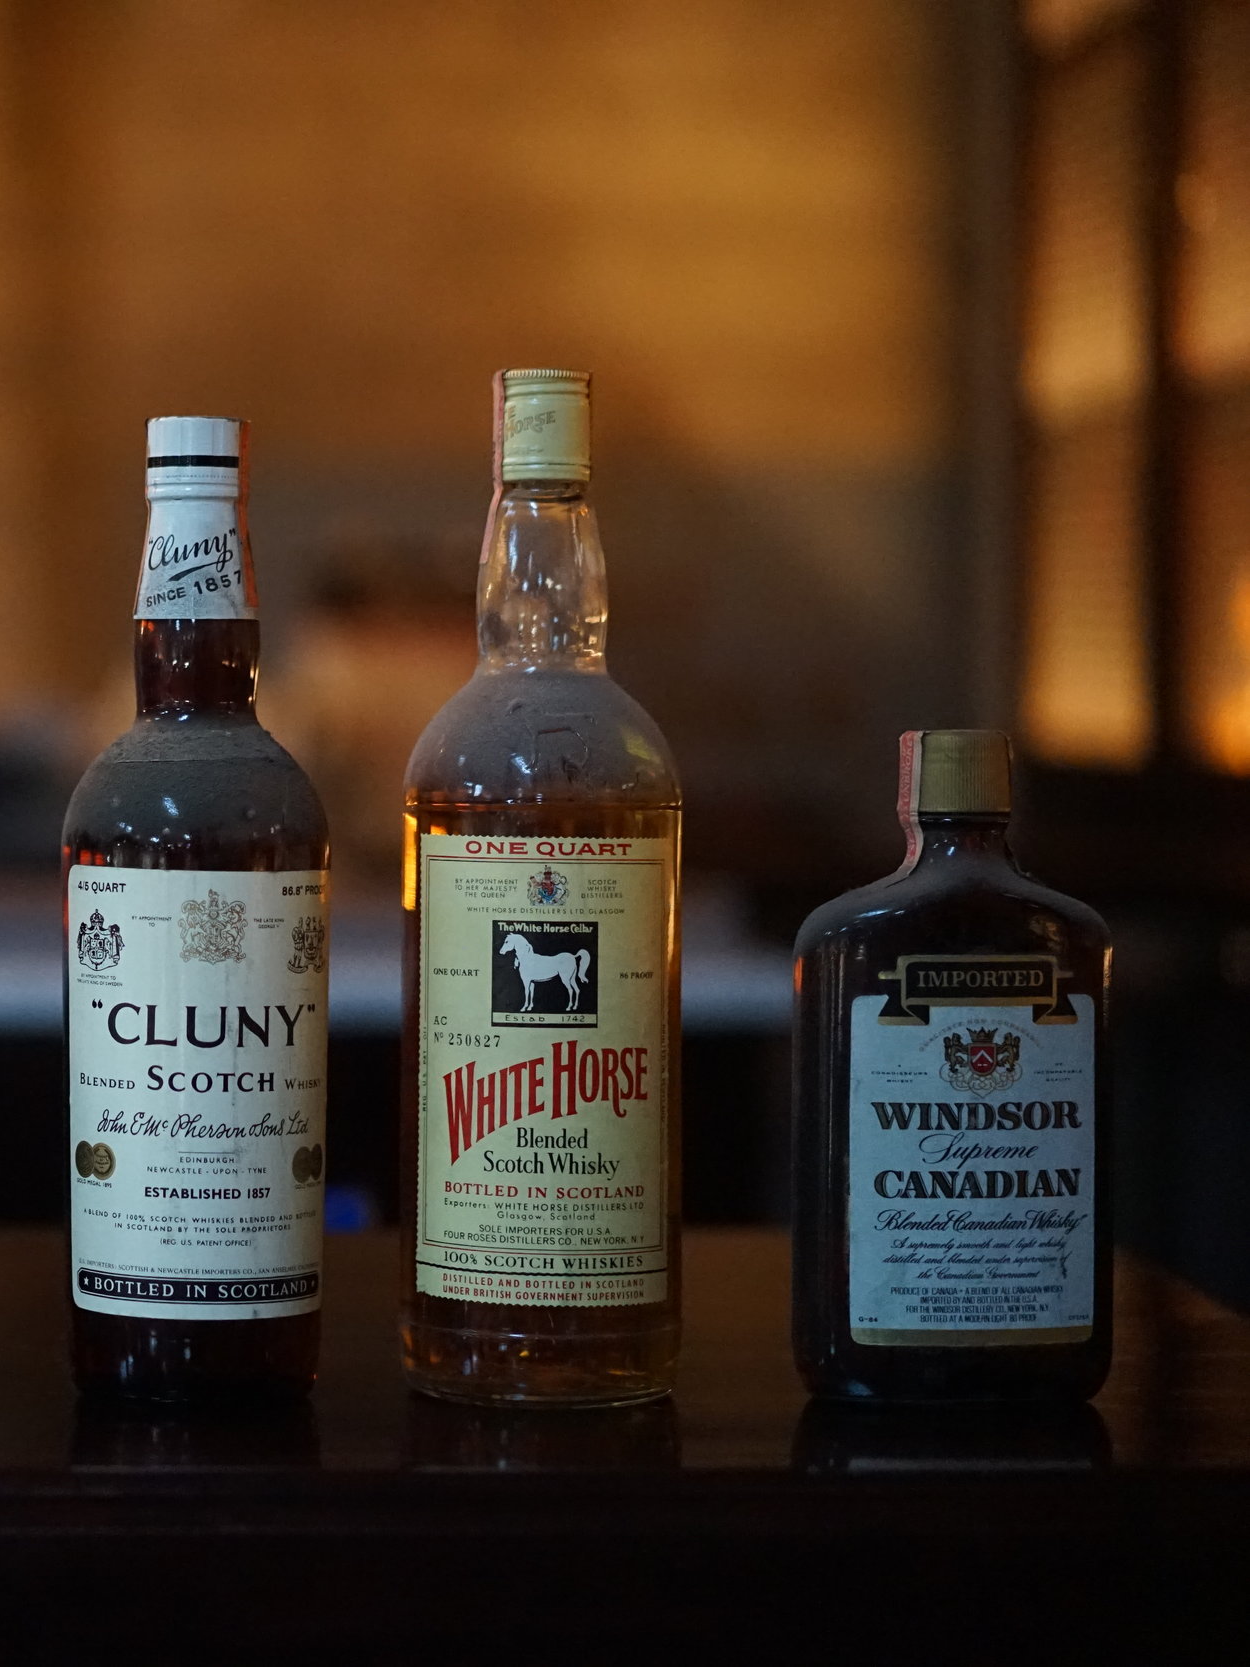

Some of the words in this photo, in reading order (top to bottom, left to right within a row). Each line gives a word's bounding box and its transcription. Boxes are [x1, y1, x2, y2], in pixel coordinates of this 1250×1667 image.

[146, 587, 186, 607] SINCE
[194, 570, 242, 595] 1857
[465, 840, 528, 855] ONE
[536, 842, 632, 857] QUART
[78, 881, 89, 890] 4/5
[92, 883, 126, 893] QUART
[498, 922, 514, 932] The
[513, 922, 542, 932] White
[544, 923, 569, 933] Horse
[570, 923, 593, 933] Cellar
[433, 968, 448, 976] ONE
[450, 968, 480, 977] QUART
[917, 970, 1044, 988] IMPORTED
[433, 1016, 448, 1026] AC
[448, 1033, 501, 1048] 250827
[147, 1065, 275, 1093] SCOTCH
[443, 1057, 544, 1166] WHITE
[551, 1040, 648, 1120] HORSE
[871, 1101, 1083, 1130] WINDSOR
[516, 1127, 588, 1149] Blended
[918, 1131, 1038, 1170] Supreme
[147, 1166, 202, 1174] NEWCASTLE
[213, 1167, 238, 1175] UPON
[483, 1150, 544, 1175] Scotch
[550, 1152, 620, 1181] Whisky
[445, 1181, 518, 1197] BOTTLED
[528, 1187, 548, 1198] IN
[557, 1185, 644, 1199] SCOTLAND
[874, 1167, 1081, 1199] CANADIAN
[145, 1187, 241, 1199] ESTABLISHED
[247, 1187, 271, 1199] 1857
[550, 1211, 595, 1221] Scotland
[875, 1208, 950, 1232] Blended
[947, 1210, 1027, 1232] Canadian
[1025, 1208, 1088, 1235] Whisky
[127, 1224, 172, 1232] SCOTLAND
[479, 1224, 502, 1233] SOLE
[505, 1226, 563, 1235] IMPORTERS
[444, 1251, 478, 1264] 100%
[484, 1255, 554, 1269] SCOTCH
[562, 1256, 643, 1269] WHISKIES
[94, 1277, 174, 1297] BOTTLED
[186, 1285, 207, 1298] IN
[219, 1280, 307, 1299] SCOTLAND
[443, 1273, 493, 1286] DISTILLED
[498, 1279, 520, 1288] AND
[525, 1280, 575, 1289] BOTTLED
[581, 1280, 591, 1289] IN
[596, 1279, 644, 1289] SCOTLAND
[443, 1284, 470, 1296] UNDER
[474, 1289, 511, 1299] BRITISH
[515, 1292, 582, 1301] GOVERNMENT
[587, 1290, 644, 1301] SUPERVISION
